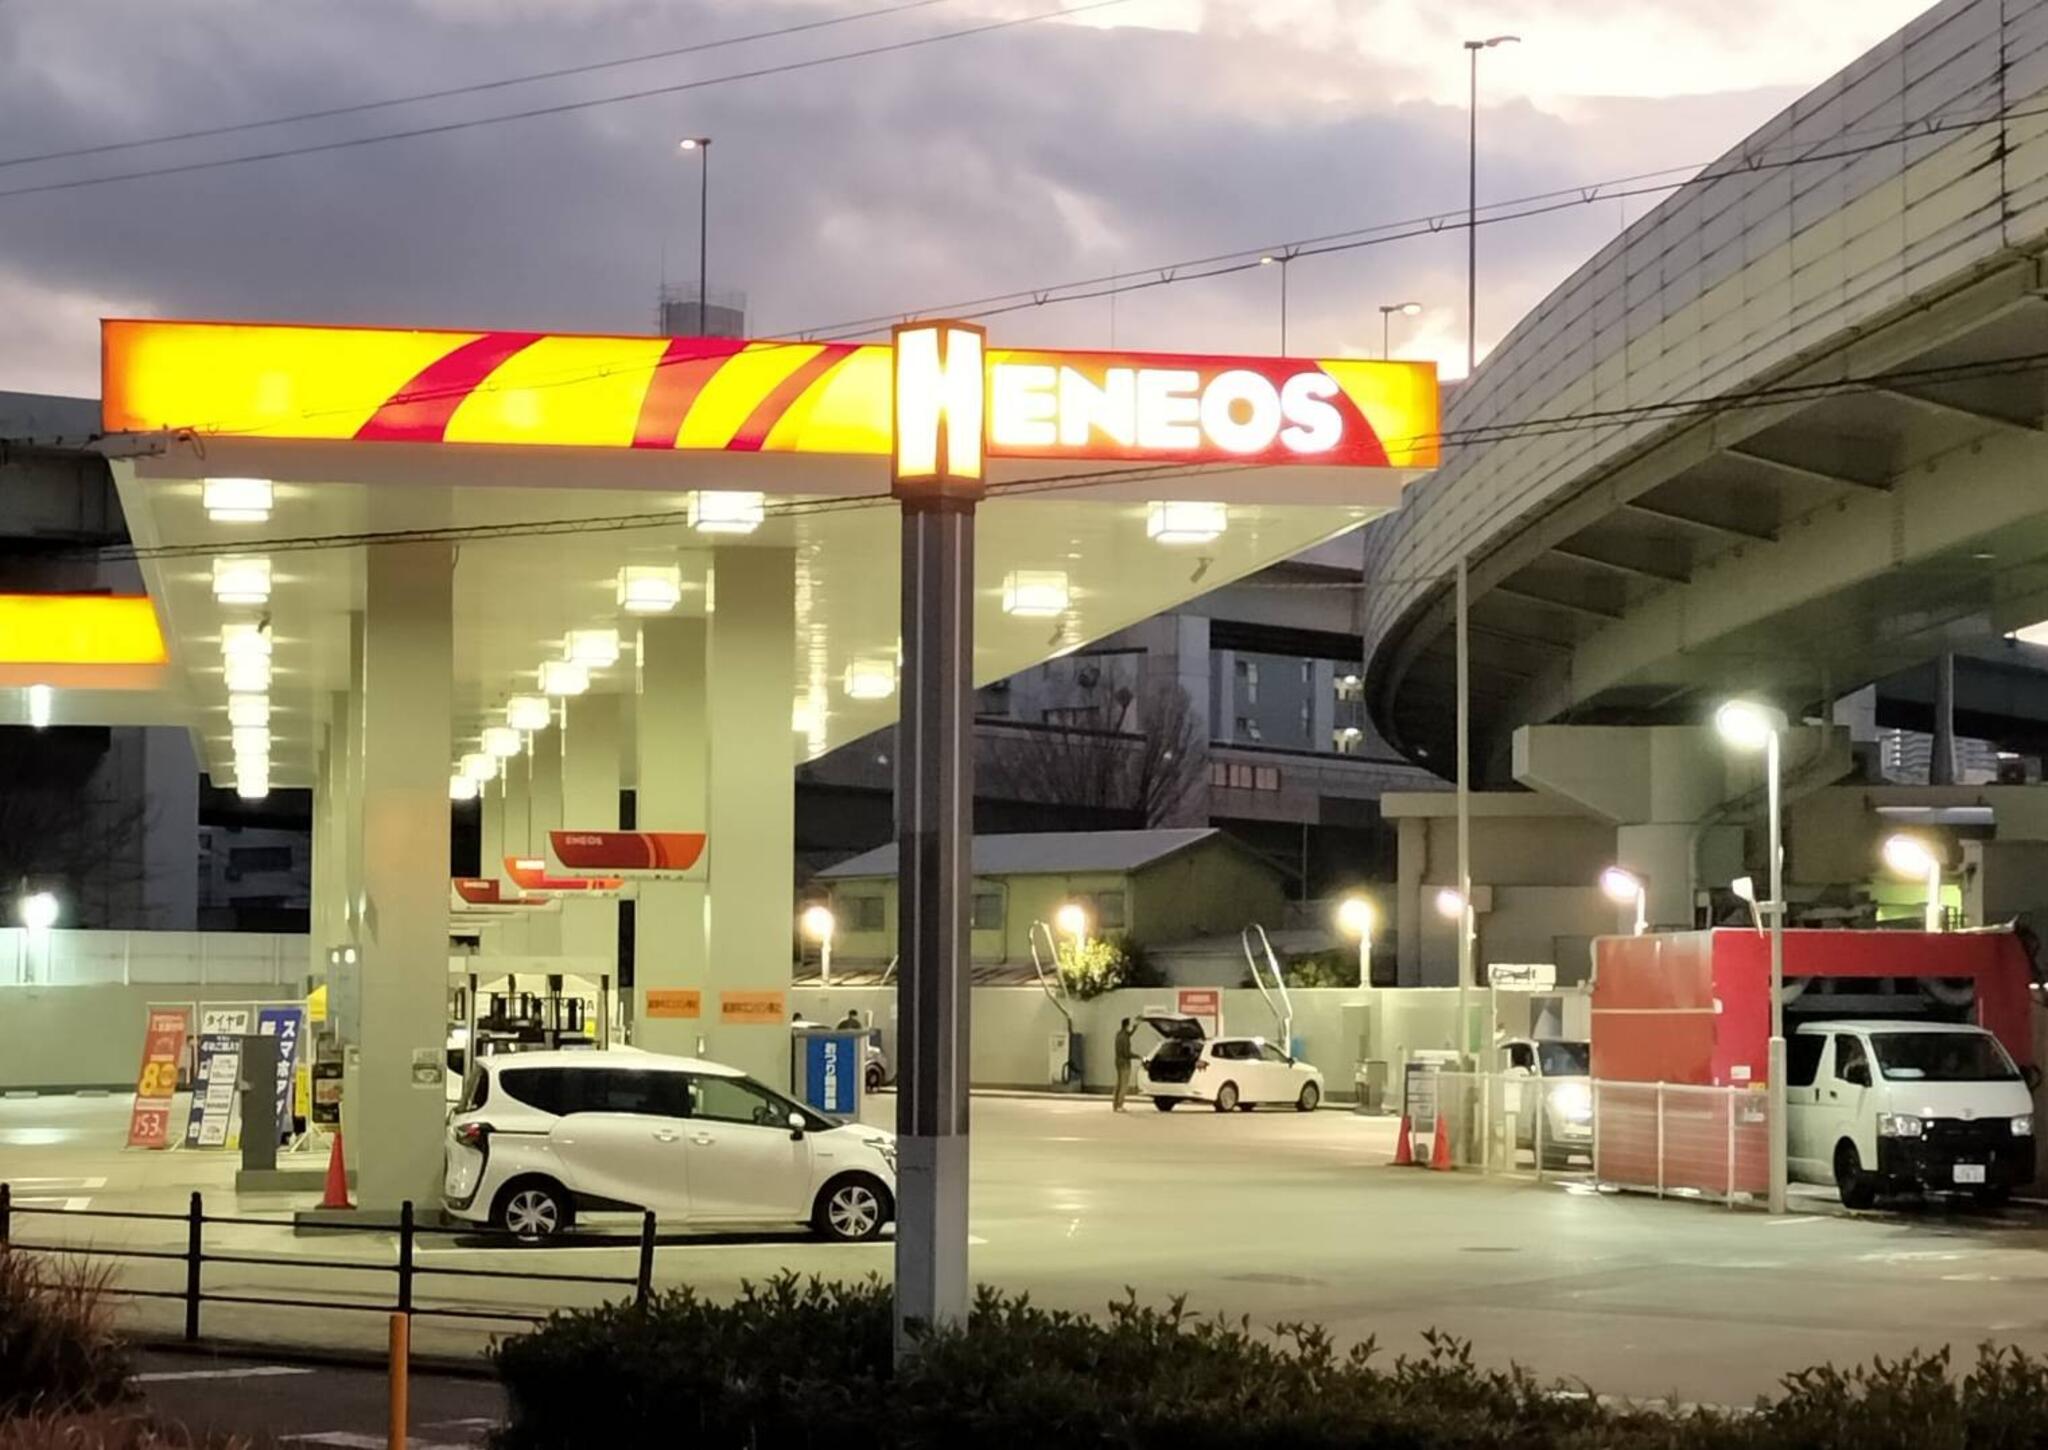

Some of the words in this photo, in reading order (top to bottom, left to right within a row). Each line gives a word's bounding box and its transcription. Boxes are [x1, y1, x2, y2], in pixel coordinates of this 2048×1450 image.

[992, 363, 1344, 453] ENEOS
[205, 1014, 246, 1028] タイヤ
